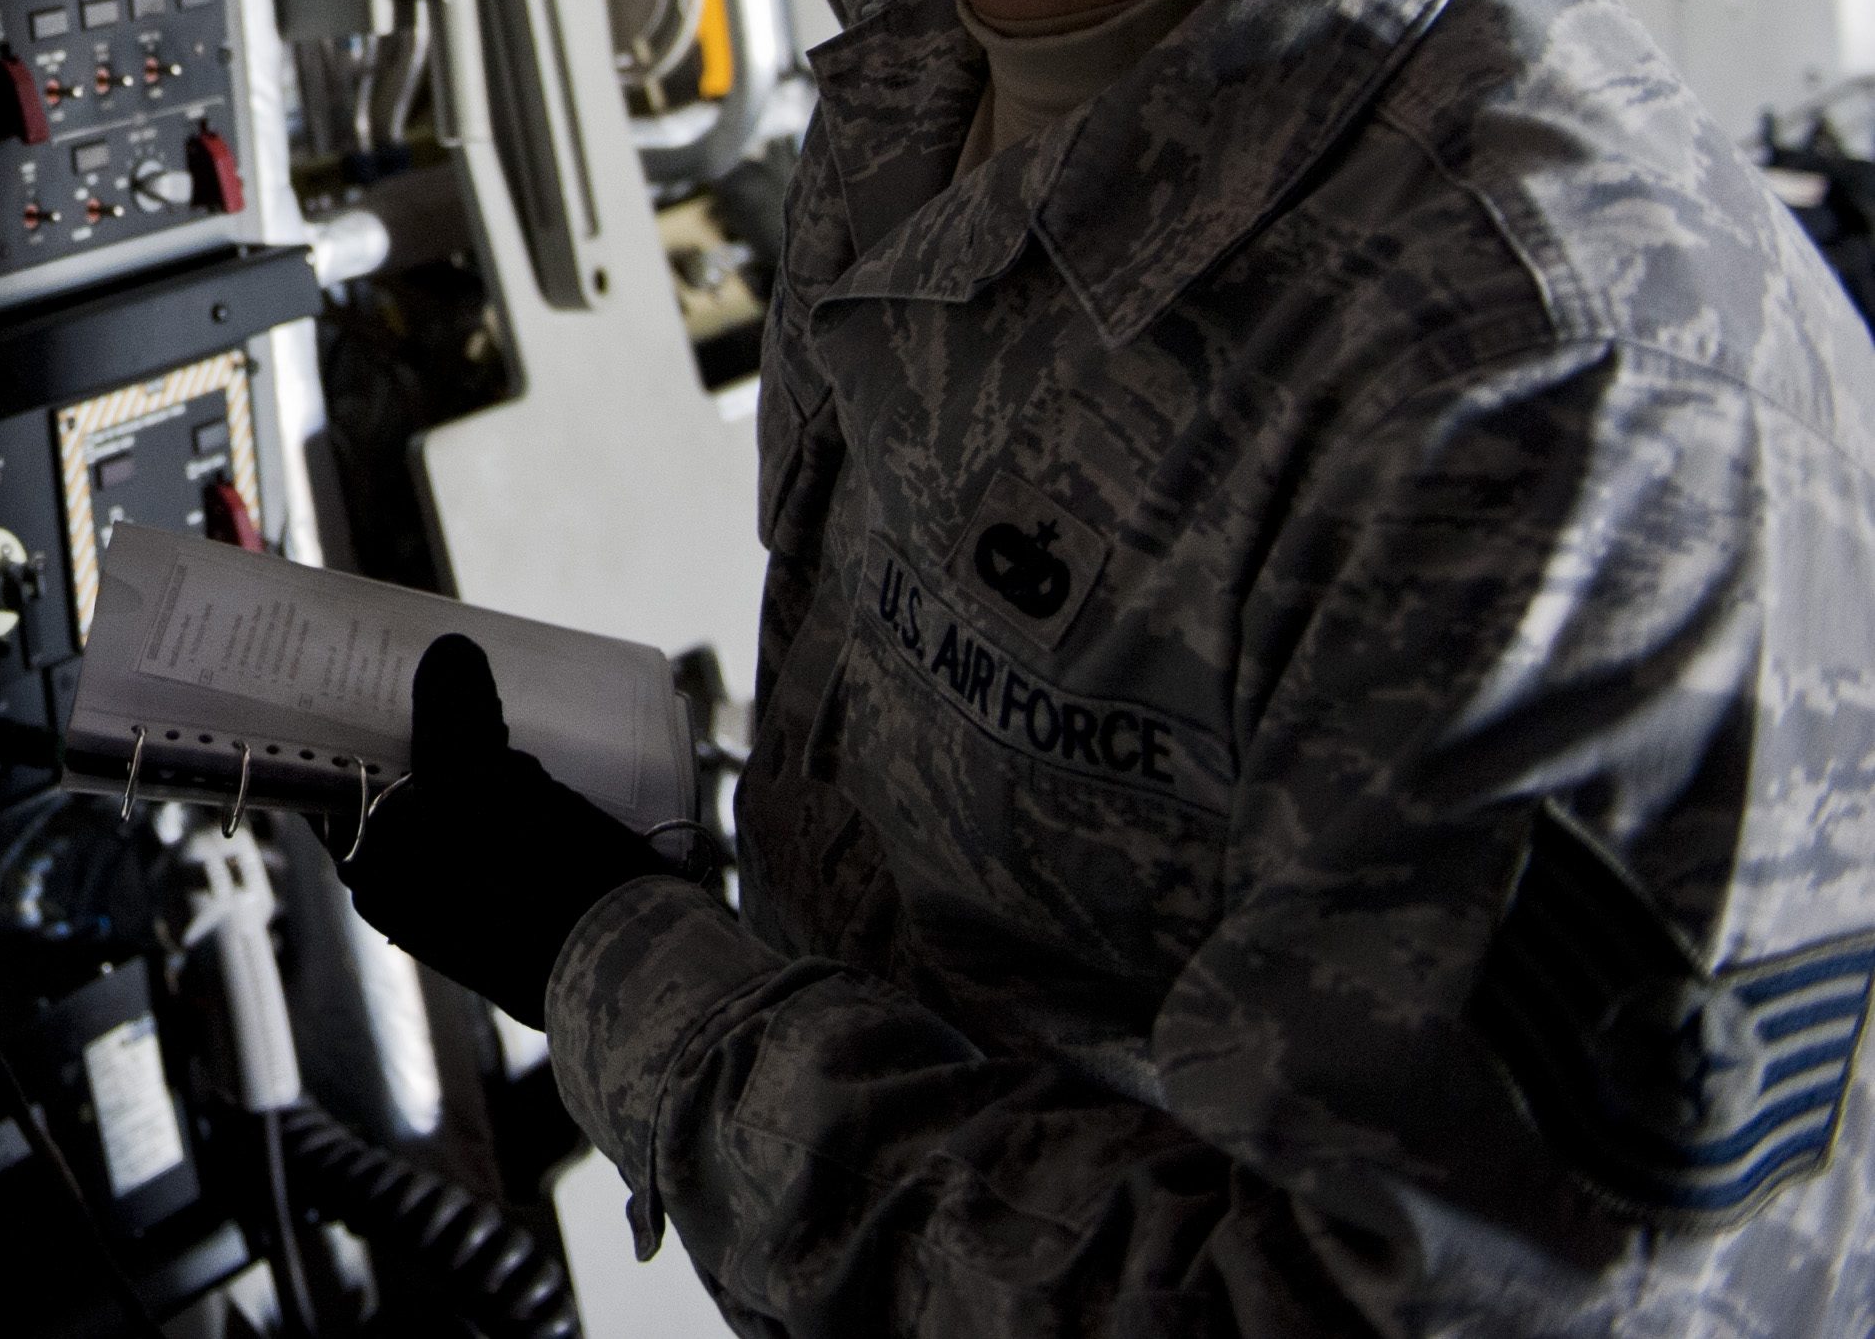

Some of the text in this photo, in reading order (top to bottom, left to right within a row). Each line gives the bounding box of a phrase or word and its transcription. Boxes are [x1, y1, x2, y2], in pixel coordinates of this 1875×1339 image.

[879, 559, 1176, 784] U.S. AIR FORCE
